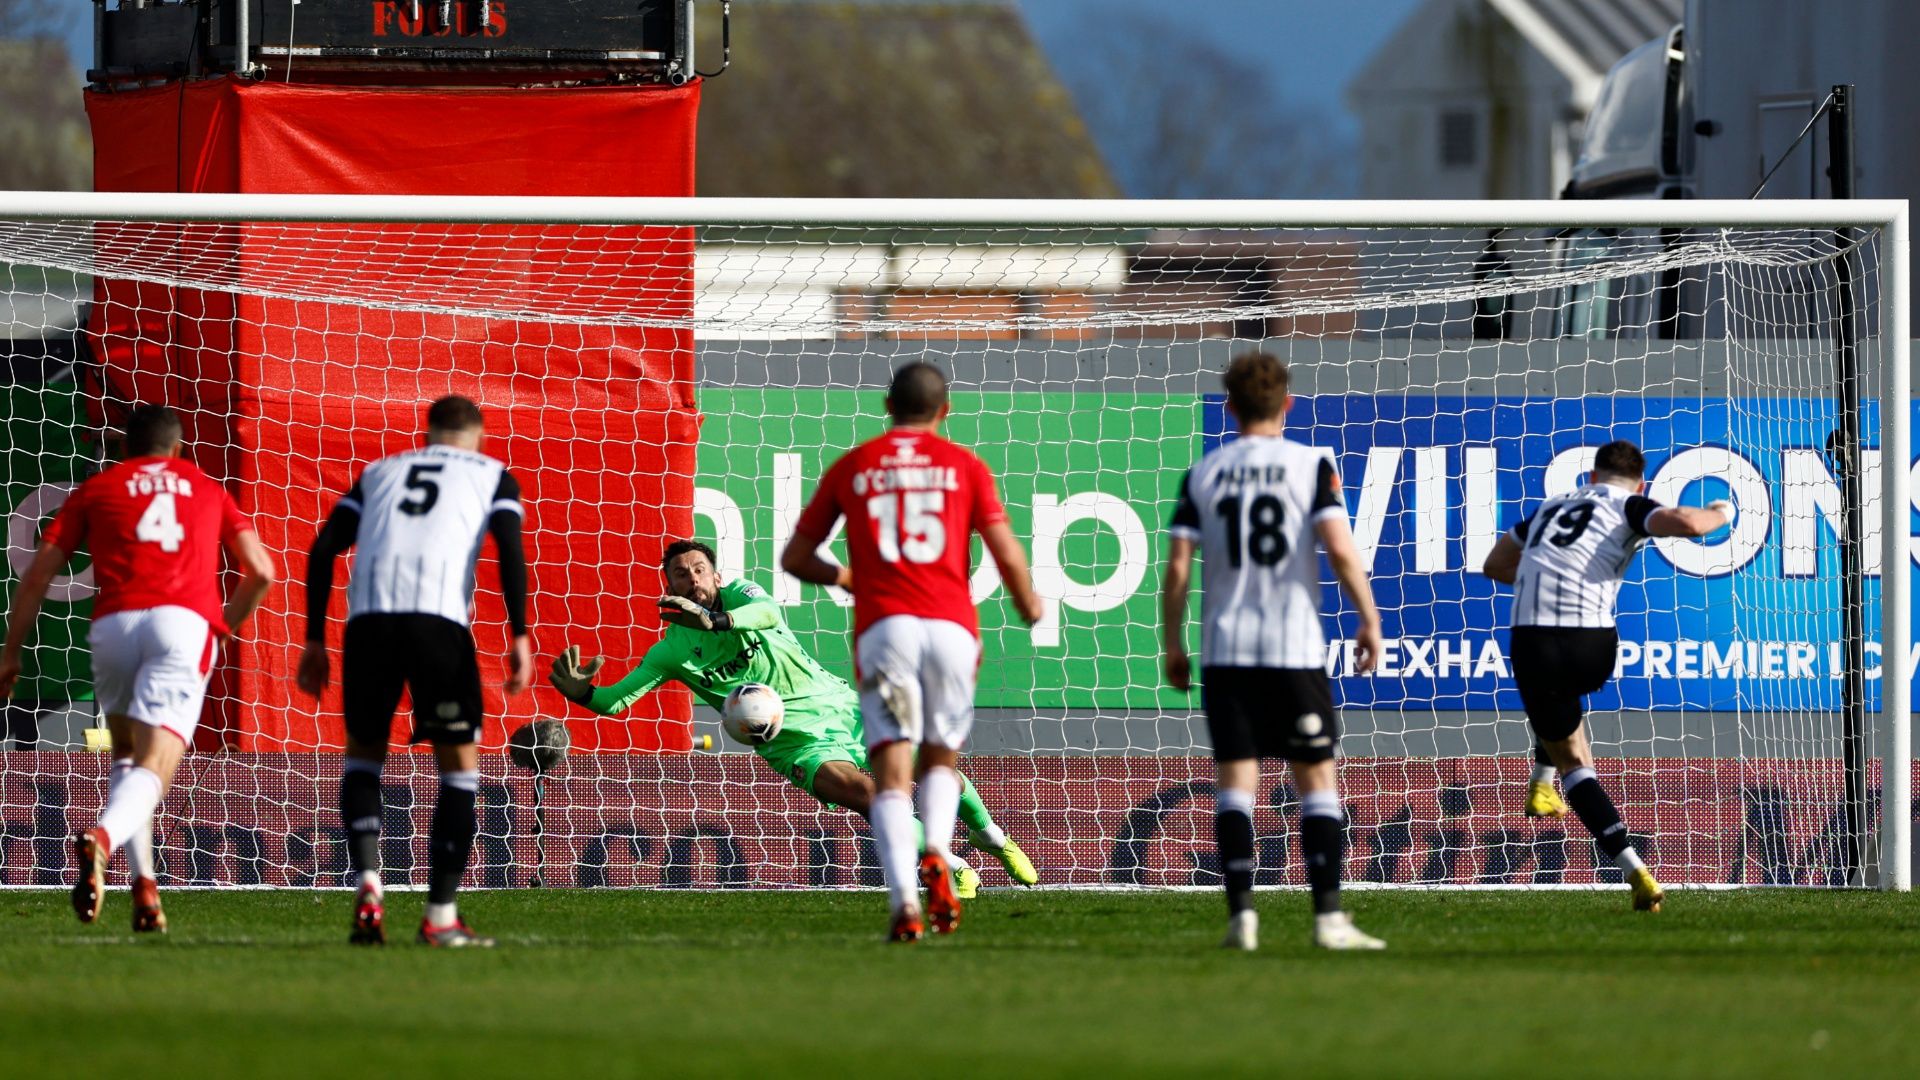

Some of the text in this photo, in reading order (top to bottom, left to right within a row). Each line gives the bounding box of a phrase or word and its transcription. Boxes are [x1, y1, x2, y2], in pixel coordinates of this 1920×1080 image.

[125, 477, 193, 498] TOZER
[397, 463, 444, 517] 5
[136, 492, 185, 552] 4
[867, 491, 946, 564] 15
[1216, 494, 1289, 570] 18
[1529, 502, 1594, 549] 19
[1613, 640, 1816, 679] PREMIER
